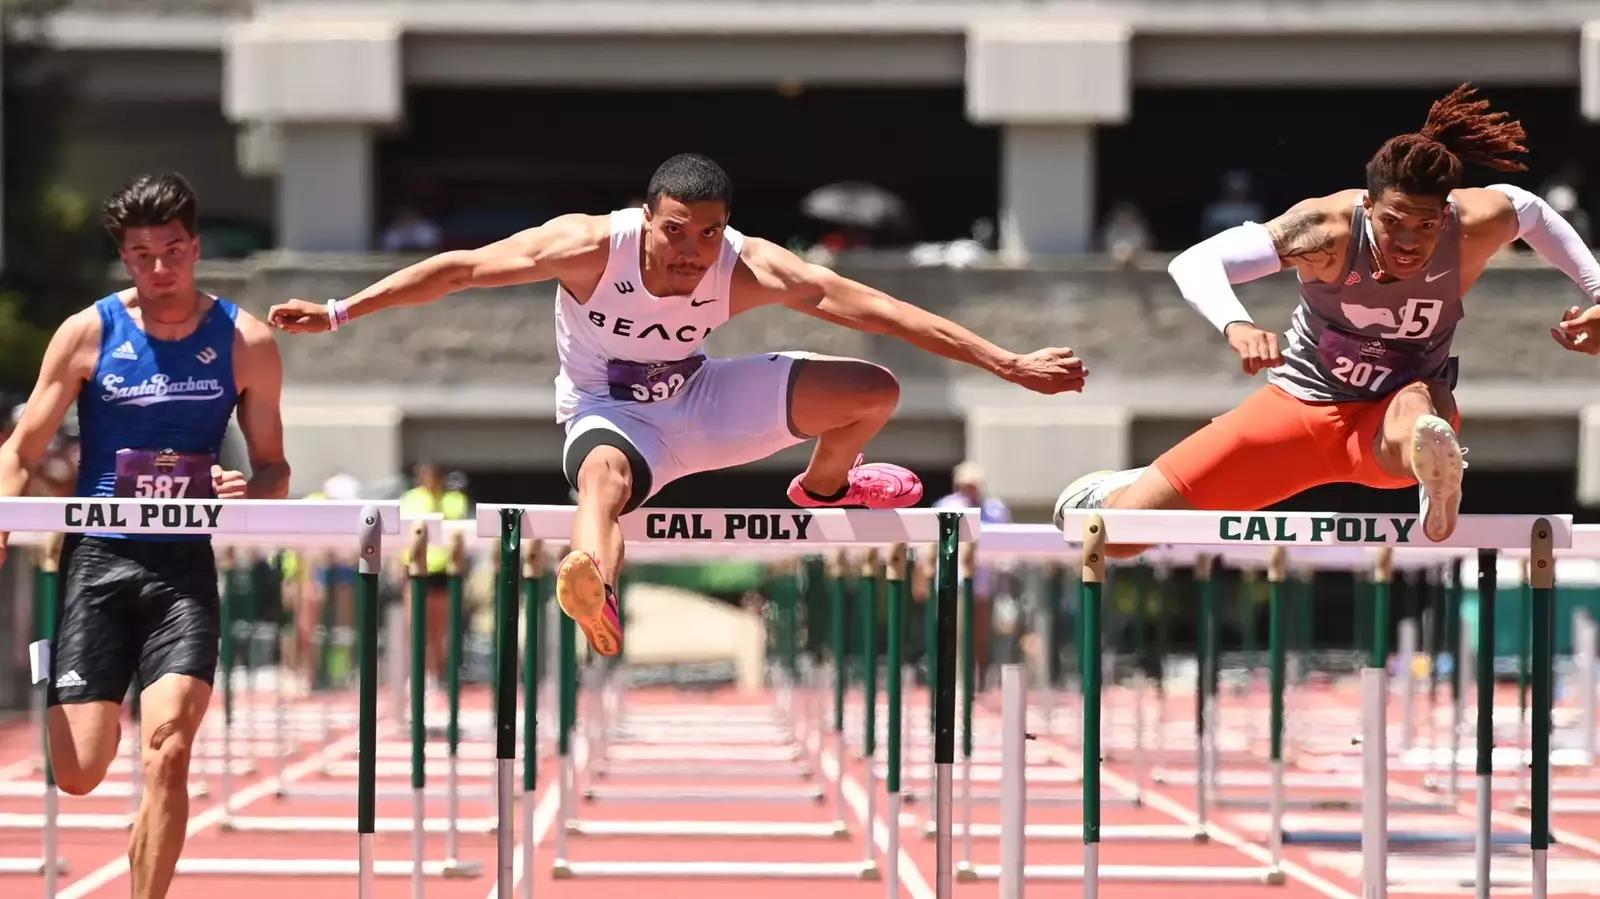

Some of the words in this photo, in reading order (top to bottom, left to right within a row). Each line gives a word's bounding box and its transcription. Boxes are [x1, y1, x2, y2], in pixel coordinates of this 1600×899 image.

[1405, 302, 1434, 337] 5
[1331, 356, 1393, 392] 207
[135, 474, 191, 499] 587
[65, 503, 127, 527] CAL
[140, 503, 223, 528] POLY
[646, 513, 712, 539] CAL
[724, 514, 813, 540] POLY
[1219, 516, 1297, 542] CAL
[1309, 517, 1417, 543] POLY
